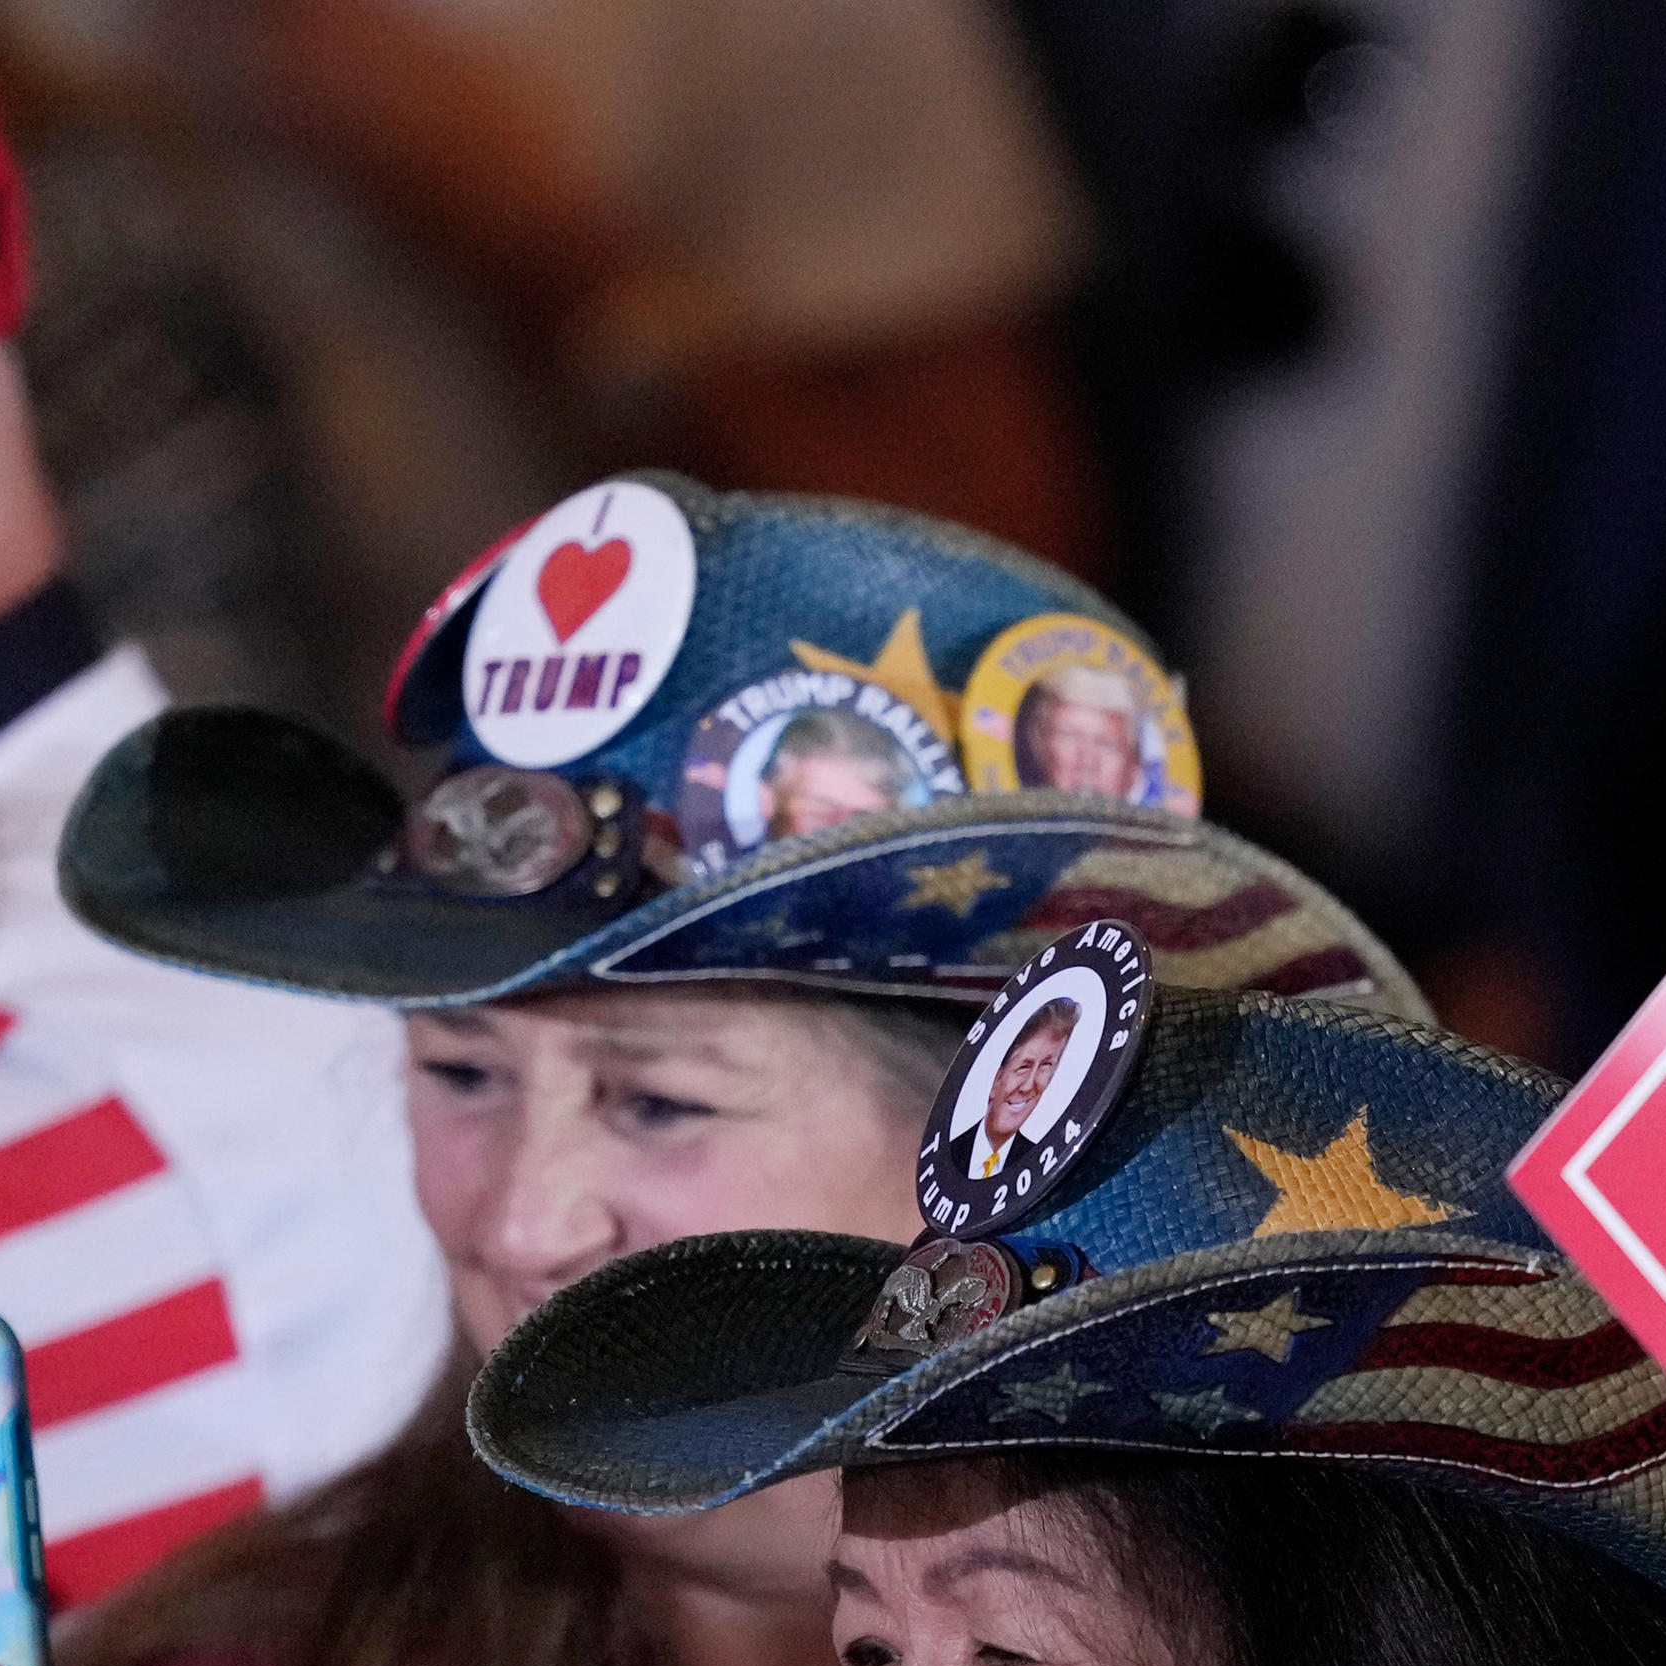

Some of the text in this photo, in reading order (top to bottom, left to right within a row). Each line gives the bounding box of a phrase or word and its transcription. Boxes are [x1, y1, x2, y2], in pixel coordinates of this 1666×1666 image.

[592, 492, 614, 535] I
[479, 653, 640, 715] TRUMP
[717, 672, 964, 794] TRUMP RALLY
[1075, 921, 1146, 1051] America
[919, 1119, 1081, 1233] Trump 2024
